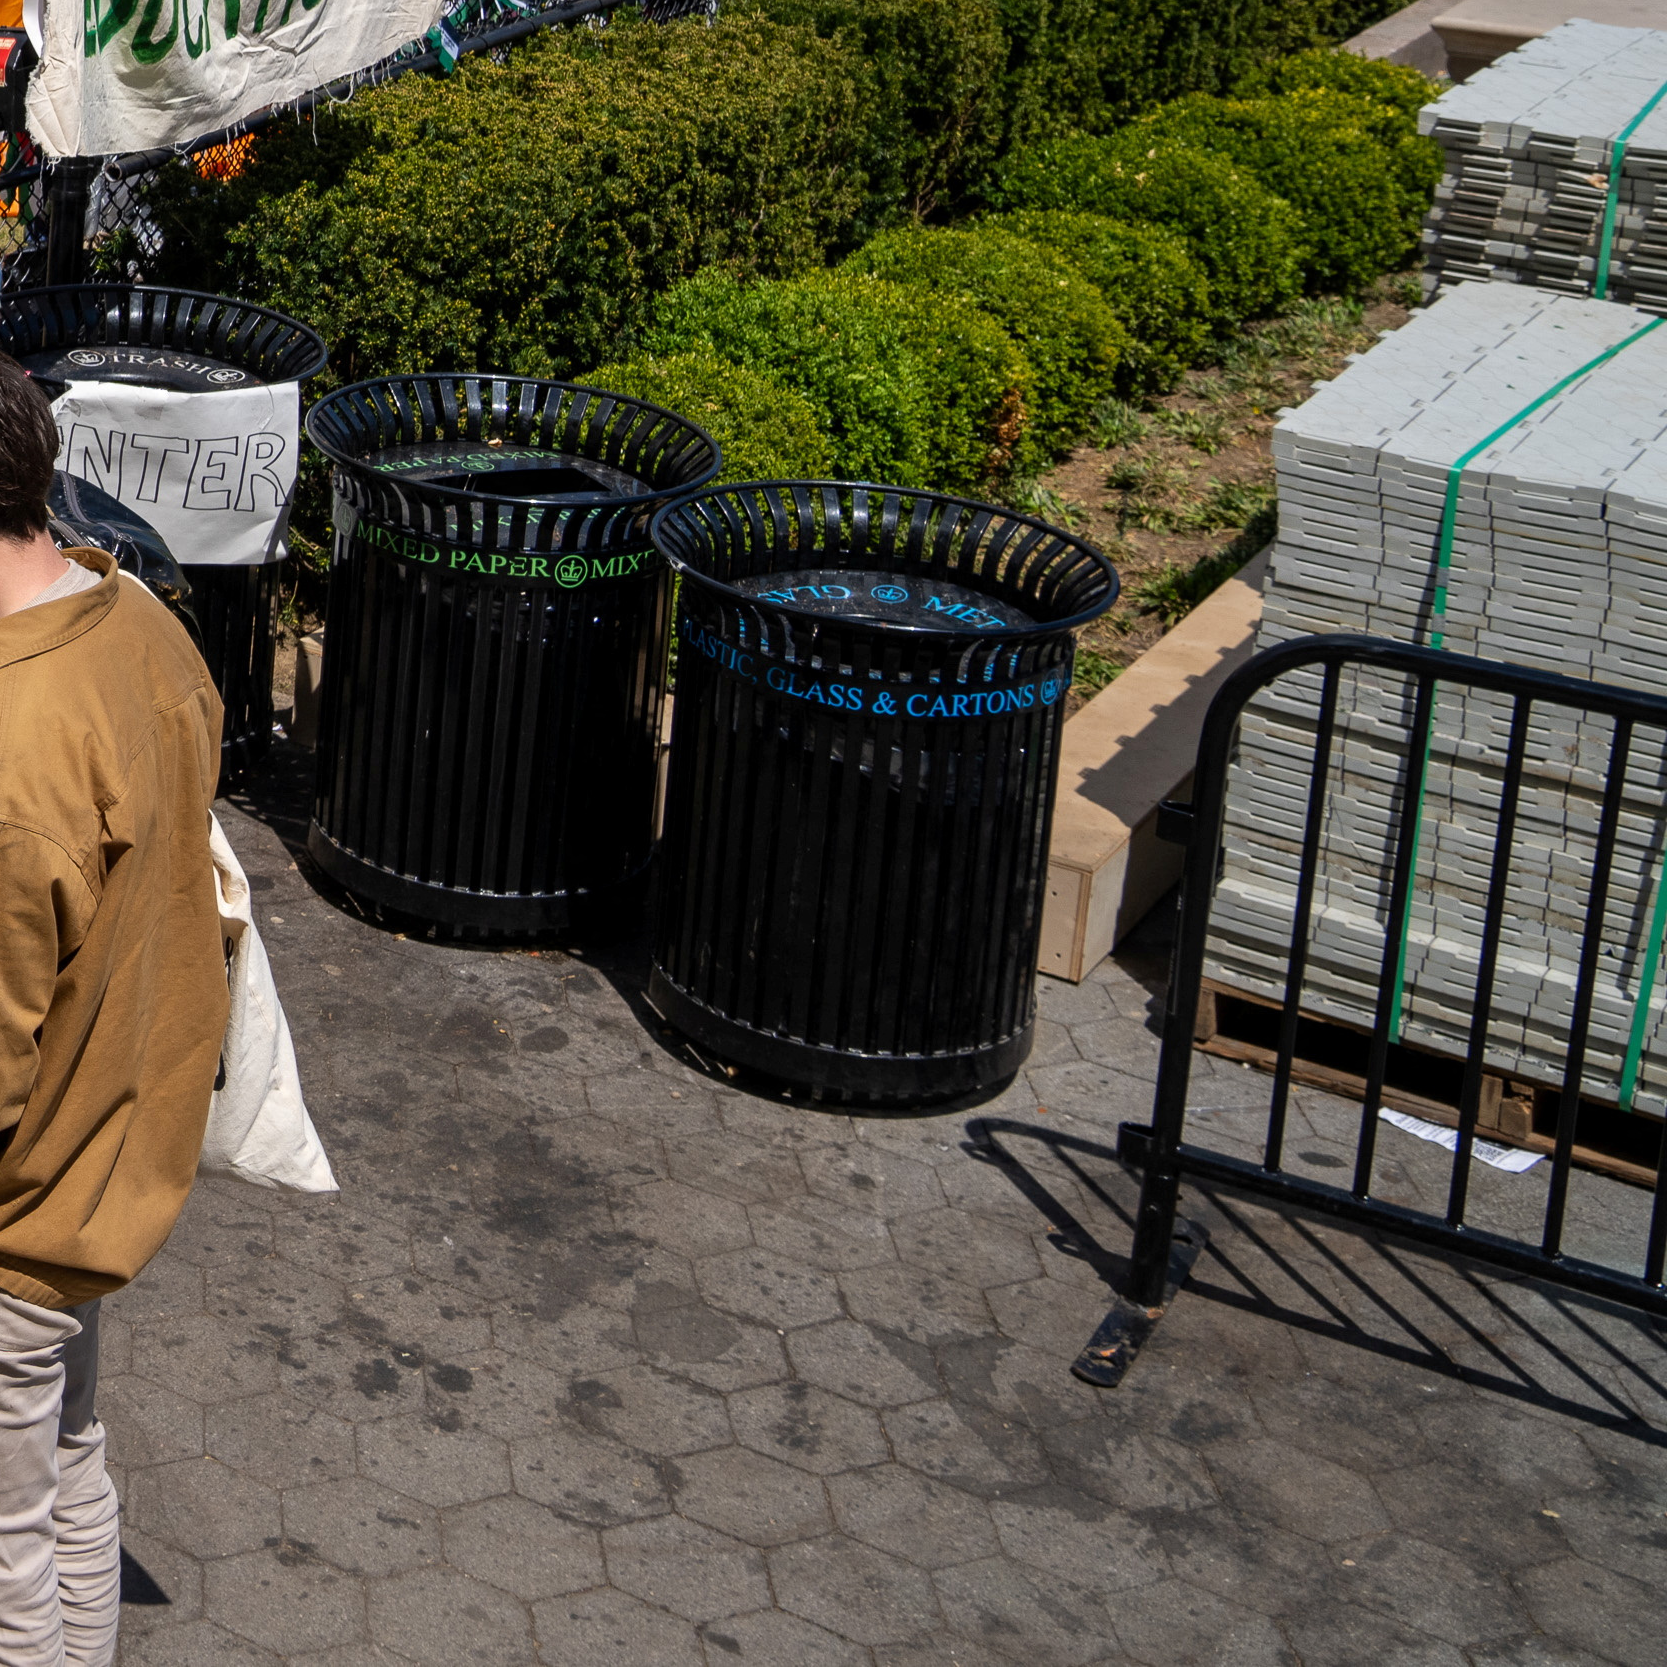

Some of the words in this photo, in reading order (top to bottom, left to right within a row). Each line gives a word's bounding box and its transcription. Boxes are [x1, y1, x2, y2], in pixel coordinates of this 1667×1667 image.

[112, 349, 211, 374] TRASH
[57, 423, 291, 512] NTER
[358, 519, 440, 564] MIXED
[449, 549, 551, 578] PAPER
[766, 666, 864, 711] GLASS
[872, 691, 898, 716] &
[906, 684, 1036, 718] CARTONS
